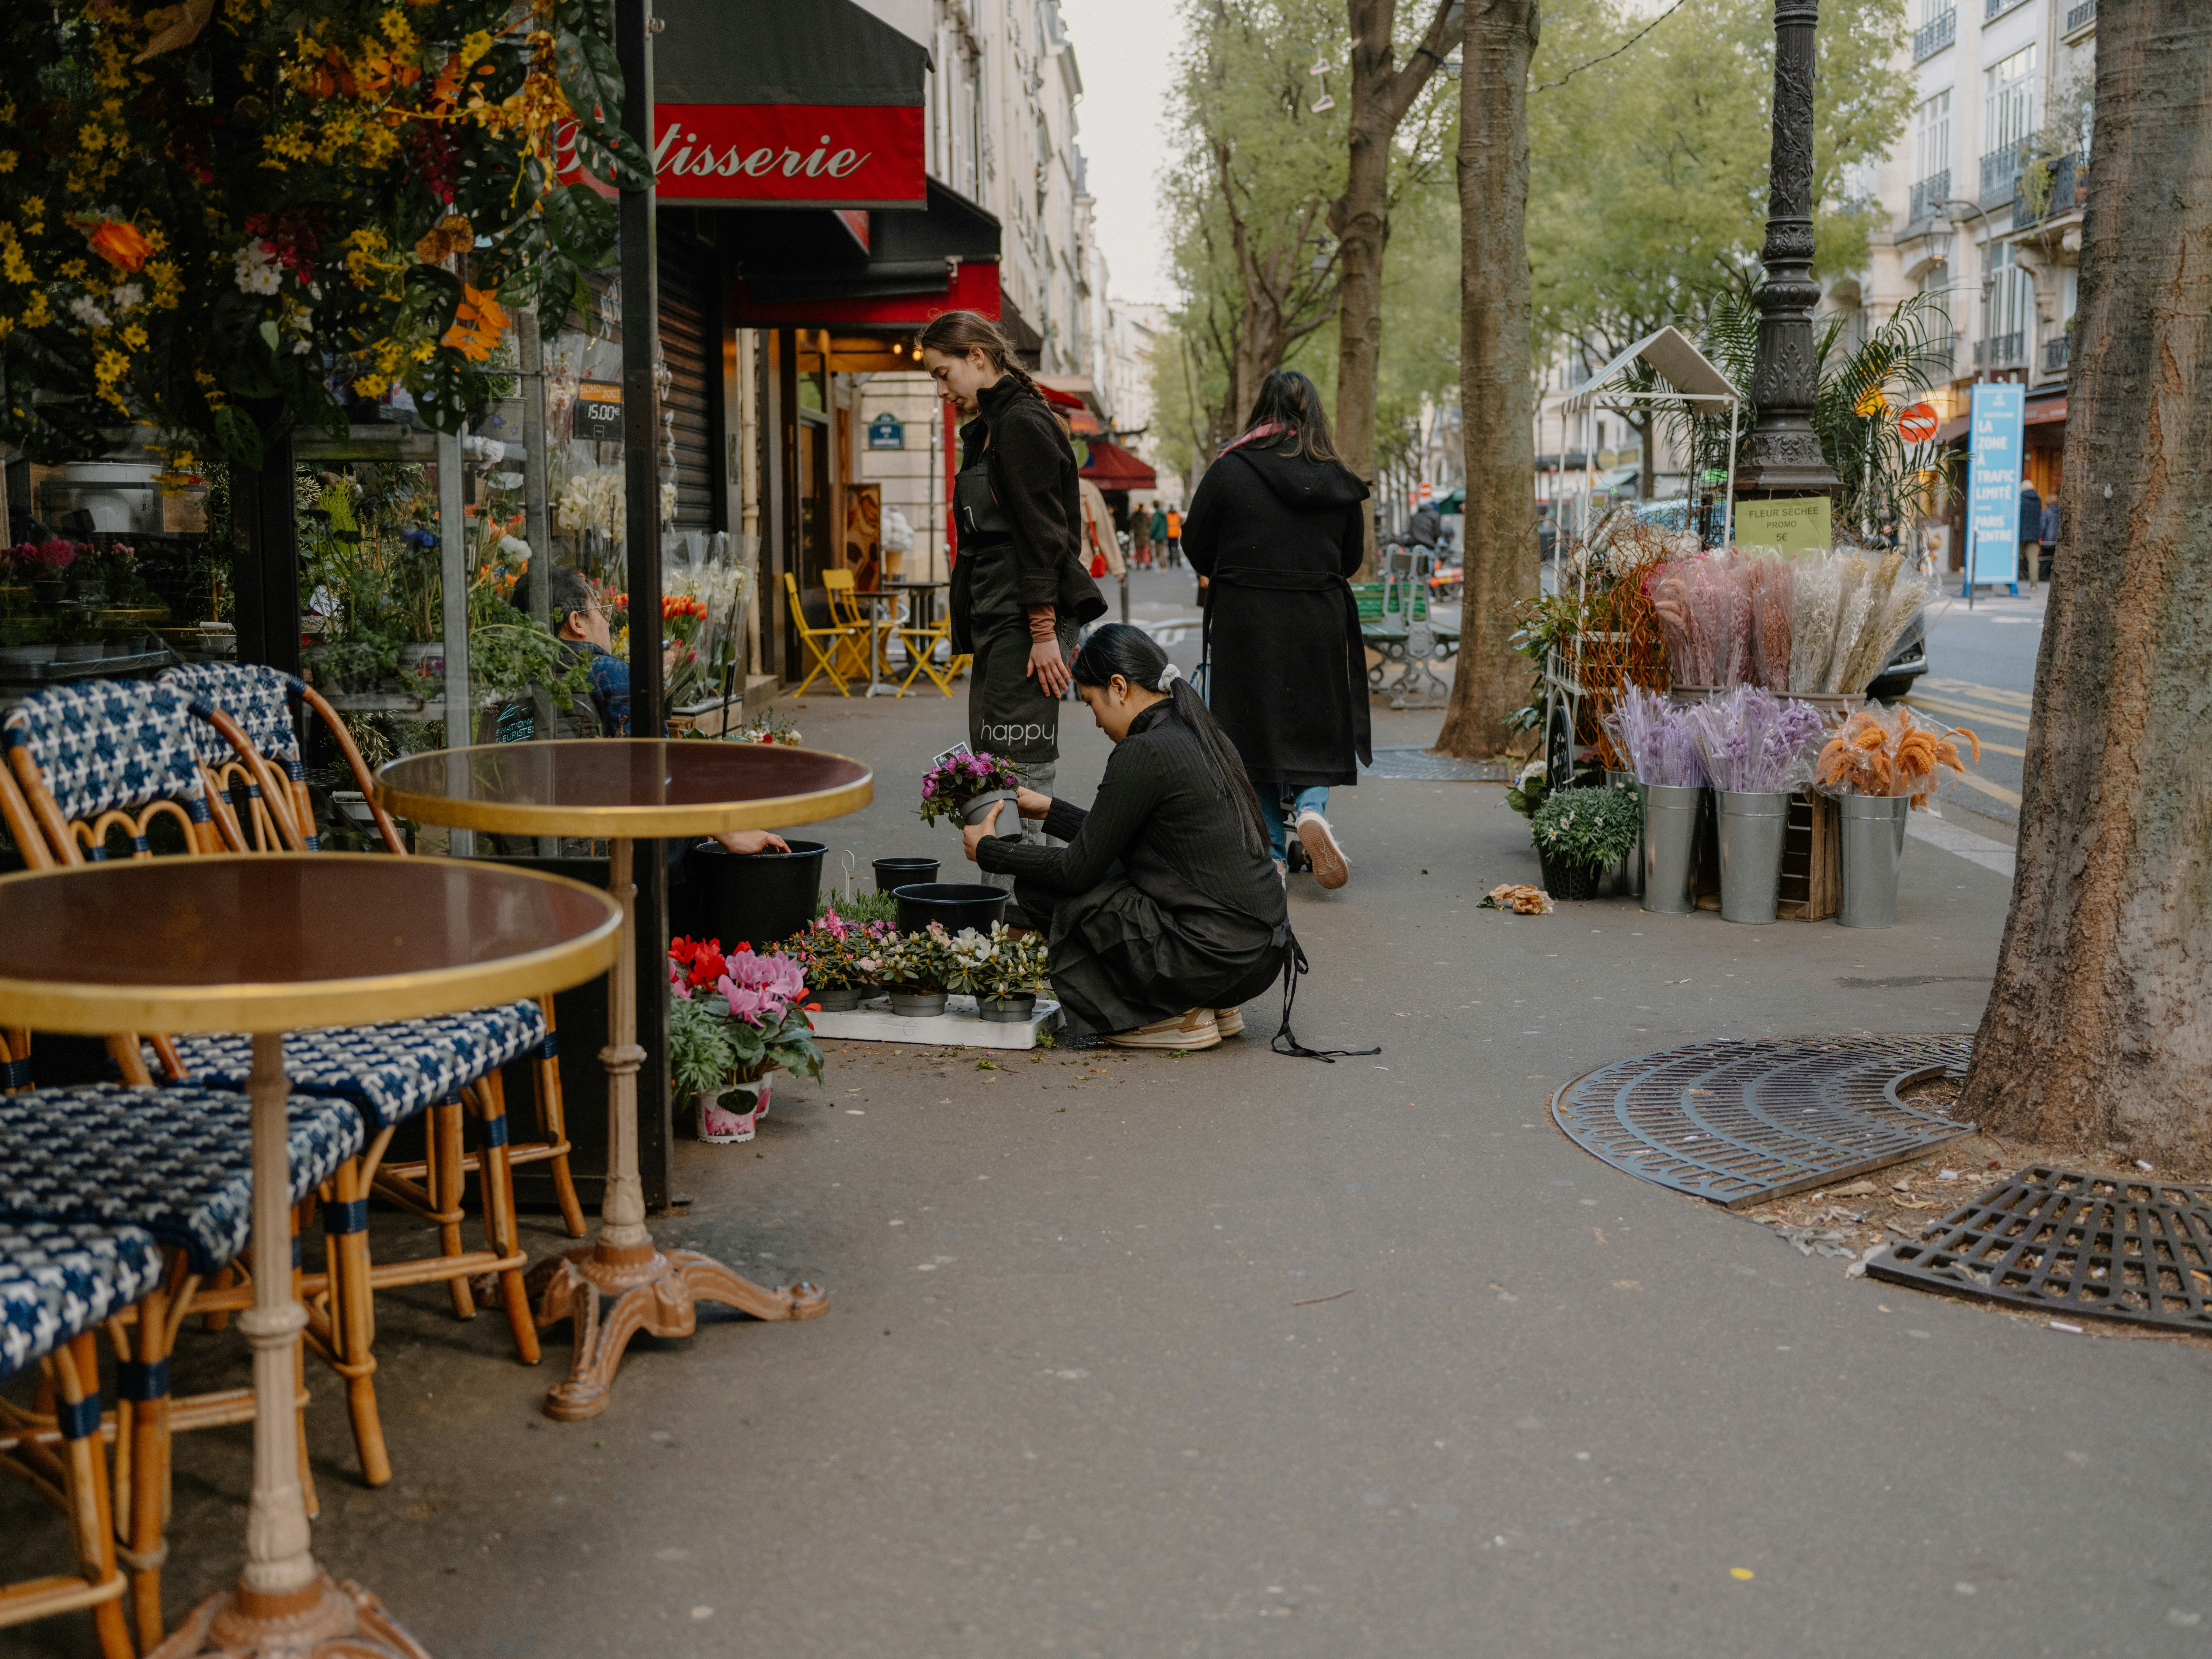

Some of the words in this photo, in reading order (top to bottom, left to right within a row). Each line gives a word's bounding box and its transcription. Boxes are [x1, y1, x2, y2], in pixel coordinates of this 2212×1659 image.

[556, 119, 872, 178] tisserie
[588, 404, 620, 421] 15.00€
[1978, 419, 1993, 434] LA
[1978, 436, 2008, 450] ZONE
[1976, 469, 2015, 483] TRAFIC
[1976, 483, 2012, 500] LIMITÉ
[1749, 509, 1779, 518] FLEUR
[1782, 506, 1818, 517] SÉCHÉE
[1975, 515, 2005, 528] PARIS
[1776, 533, 1787, 541] 5€
[981, 719, 1054, 746] happy
